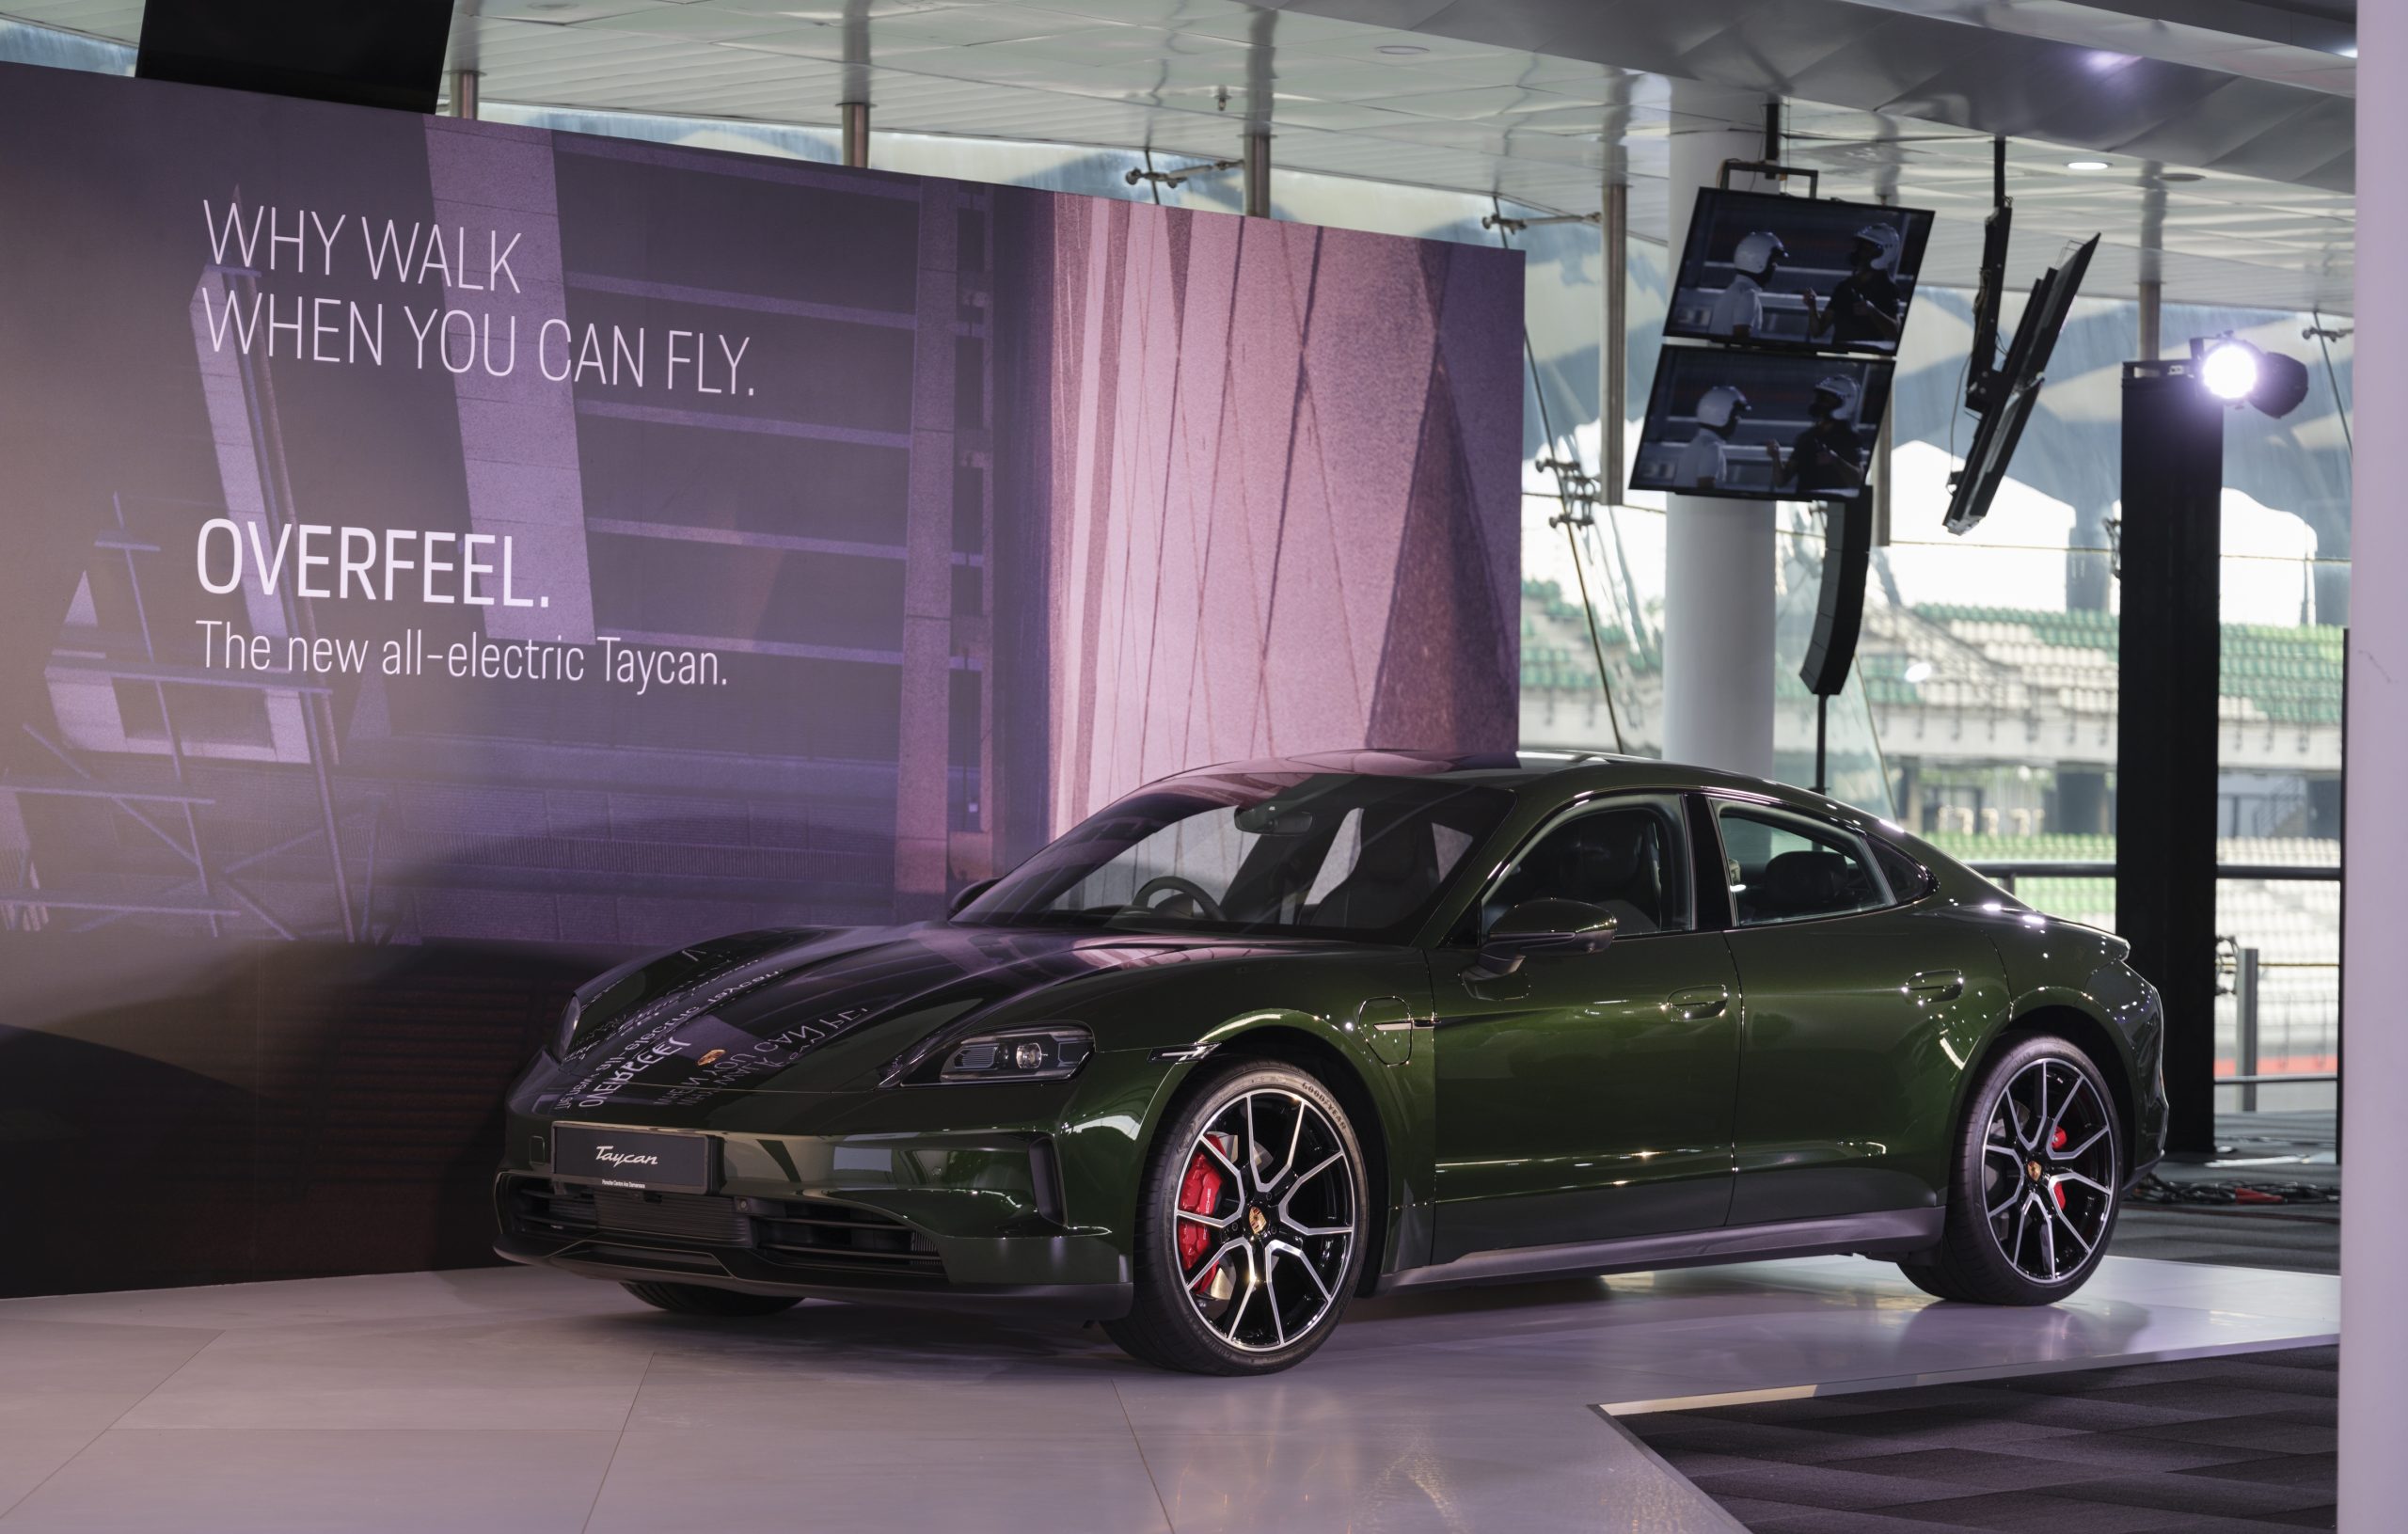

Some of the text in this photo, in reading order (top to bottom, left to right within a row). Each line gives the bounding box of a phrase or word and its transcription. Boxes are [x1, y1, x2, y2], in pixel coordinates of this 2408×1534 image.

[203, 199, 521, 293] WHY WALK
[202, 288, 753, 396] WHEN YOU CAN FLY.
[198, 518, 548, 608] OVERFEEL.
[196, 620, 726, 695] The new all-electric Taycan.
[1302, 1082, 1346, 1130] GOODYEAR
[595, 1146, 658, 1168] Taycan
